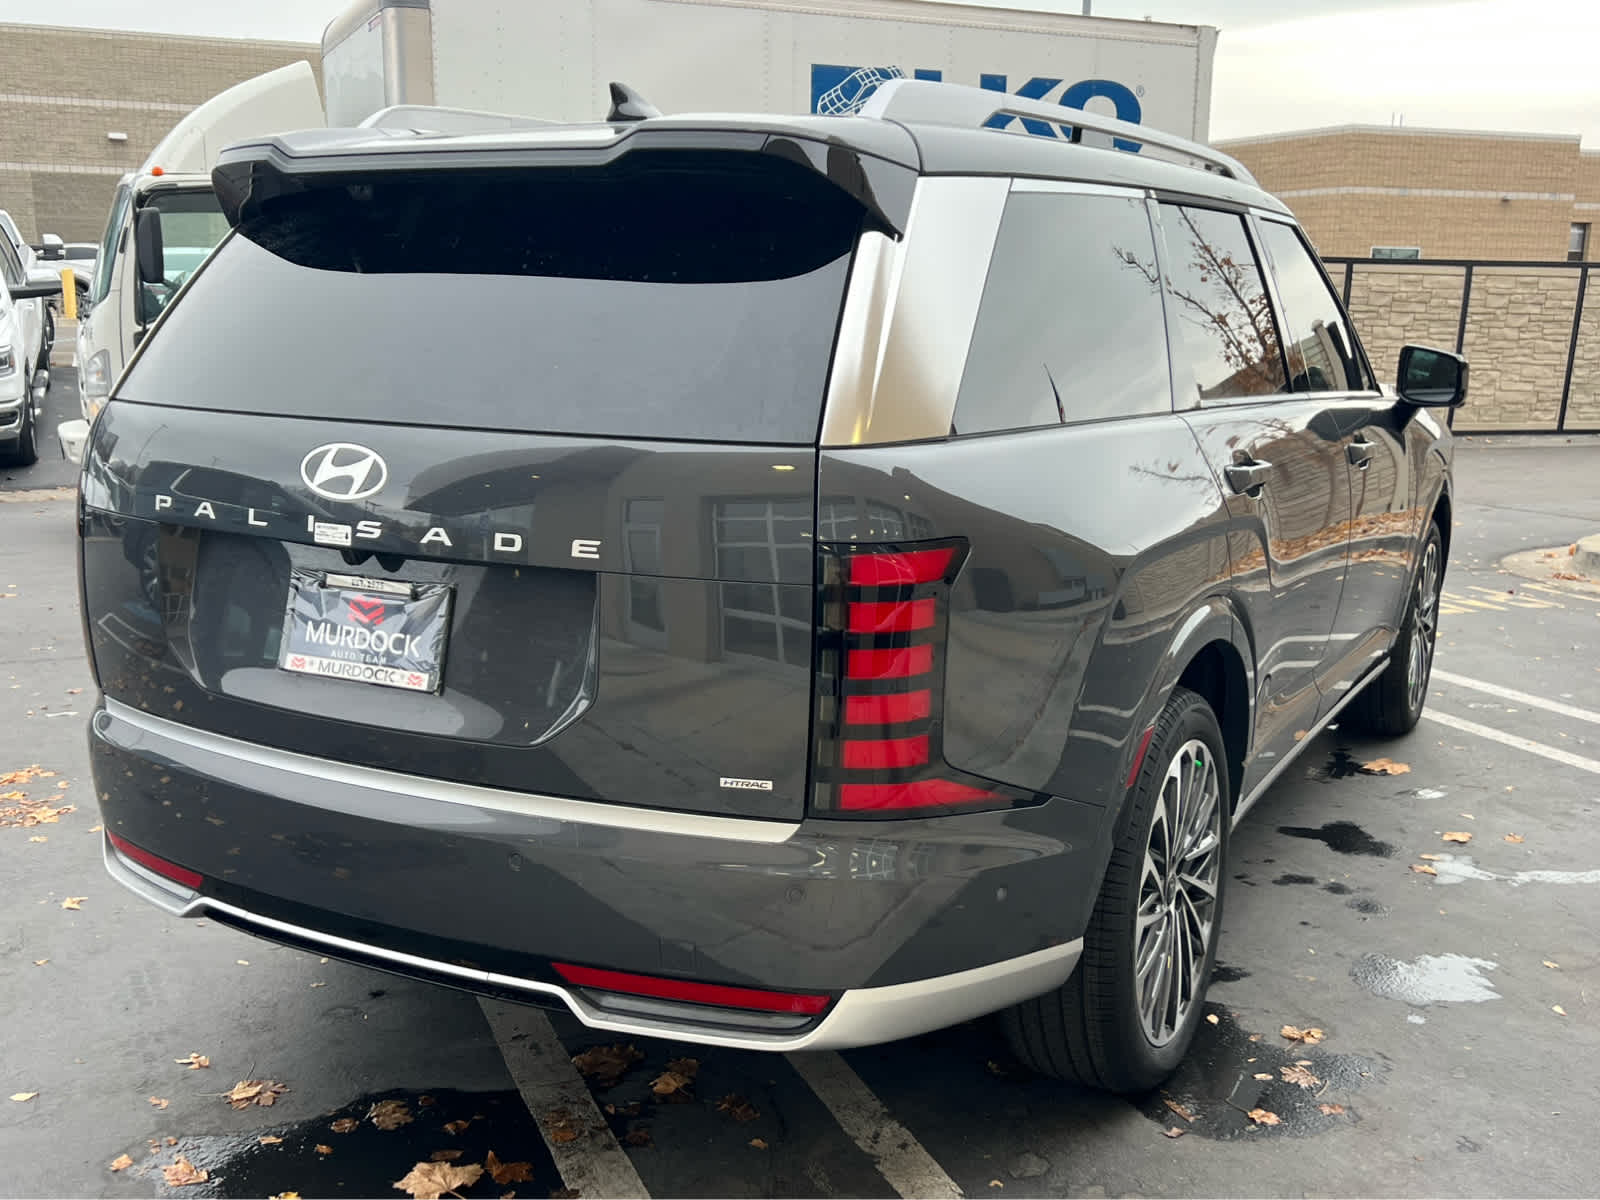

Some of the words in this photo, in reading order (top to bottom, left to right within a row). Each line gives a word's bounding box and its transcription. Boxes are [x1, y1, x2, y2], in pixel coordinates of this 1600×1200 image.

[154, 494, 602, 560] PALISADE
[305, 620, 422, 658] MURDOCK
[318, 660, 396, 683] MURDOCK
[723, 779, 770, 789] HTRAC
